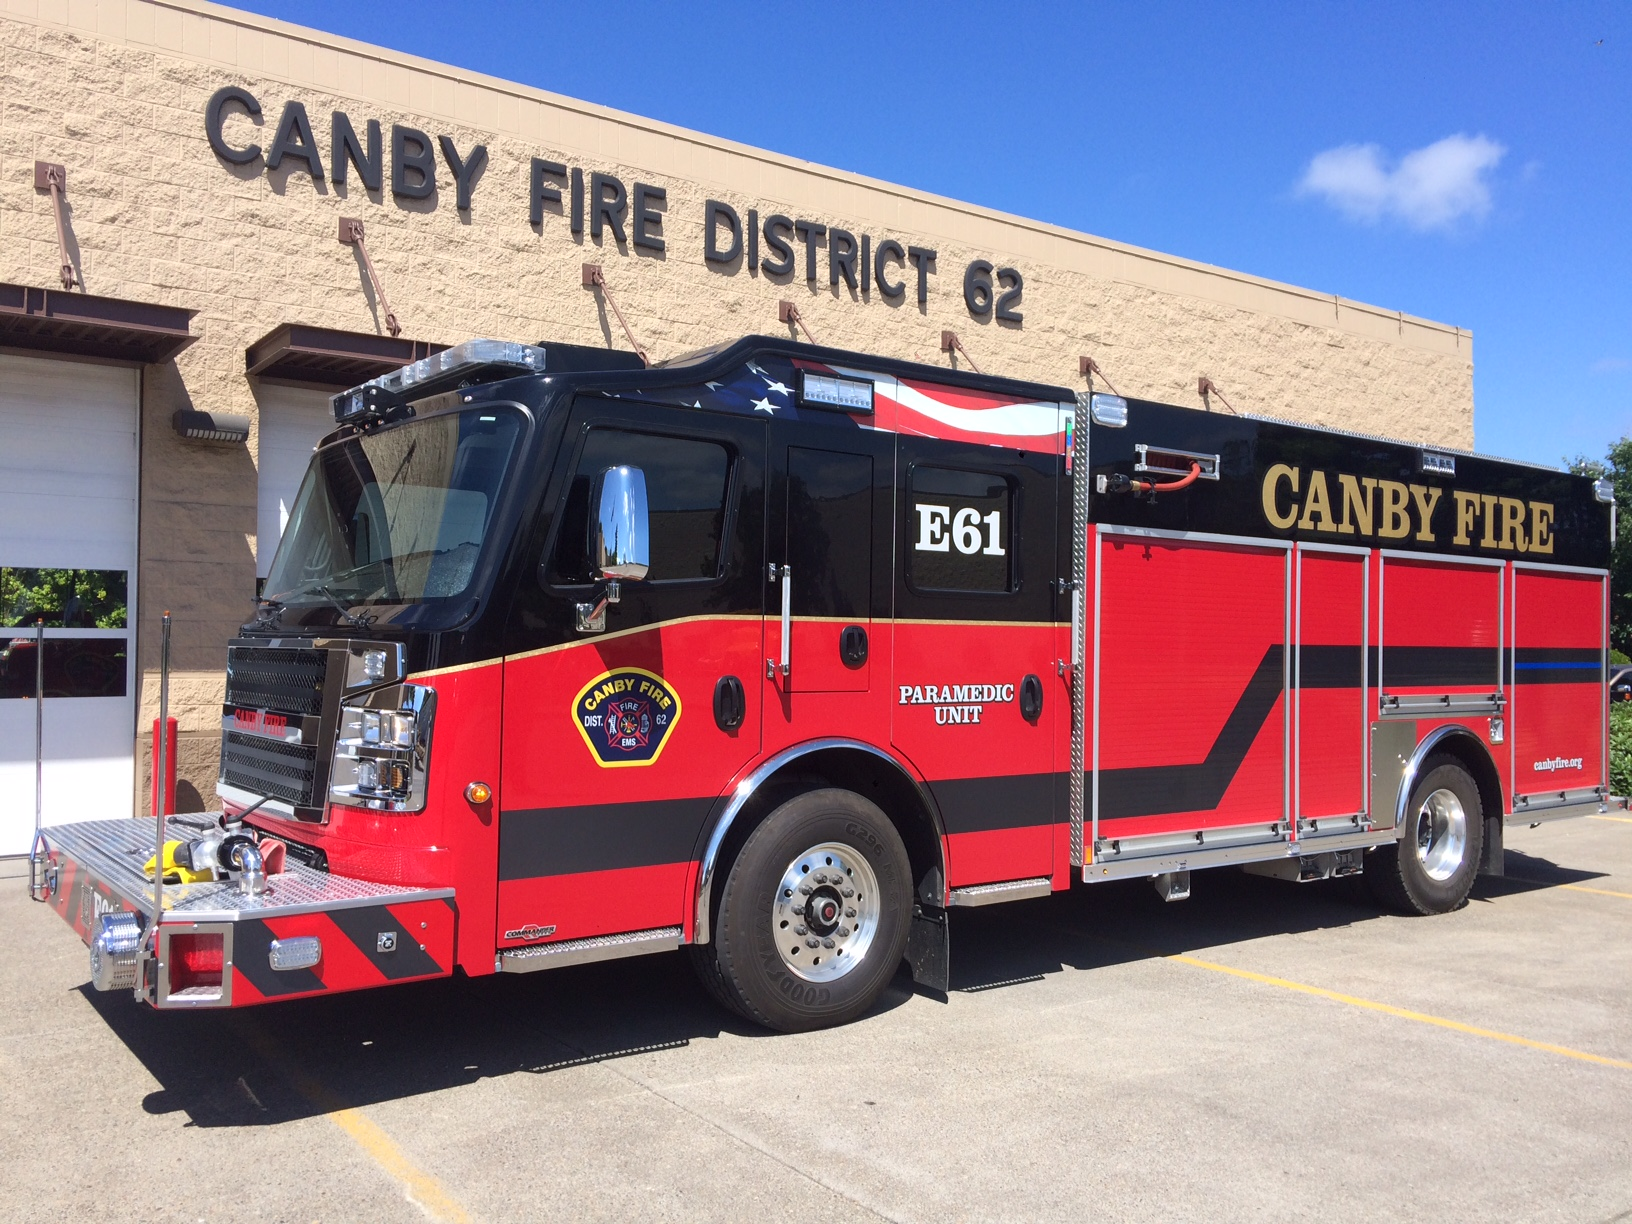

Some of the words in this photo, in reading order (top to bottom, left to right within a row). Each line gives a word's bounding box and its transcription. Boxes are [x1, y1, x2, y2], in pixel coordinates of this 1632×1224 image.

[205, 86, 487, 211] CANBY
[530, 156, 667, 251] FIRE
[705, 200, 937, 303] DISTRICT
[964, 260, 1024, 322] 62
[1262, 463, 1442, 542] CANBY
[1453, 490, 1555, 554] FIRE
[915, 503, 1006, 556] E61
[585, 679, 634, 710] CANBY
[639, 681, 672, 710] FIRE
[899, 684, 1014, 704] PARAMEDIC
[620, 702, 638, 711] FIRE
[934, 705, 982, 725] UNIT
[233, 709, 263, 732] CANBY
[263, 714, 287, 737] FIRE
[584, 715, 603, 727] DIST.
[656, 714, 667, 725] 62
[621, 738, 636, 747] EMS
[1534, 756, 1582, 772] canbyfire.org
[506, 926, 555, 937] COMMANDER
